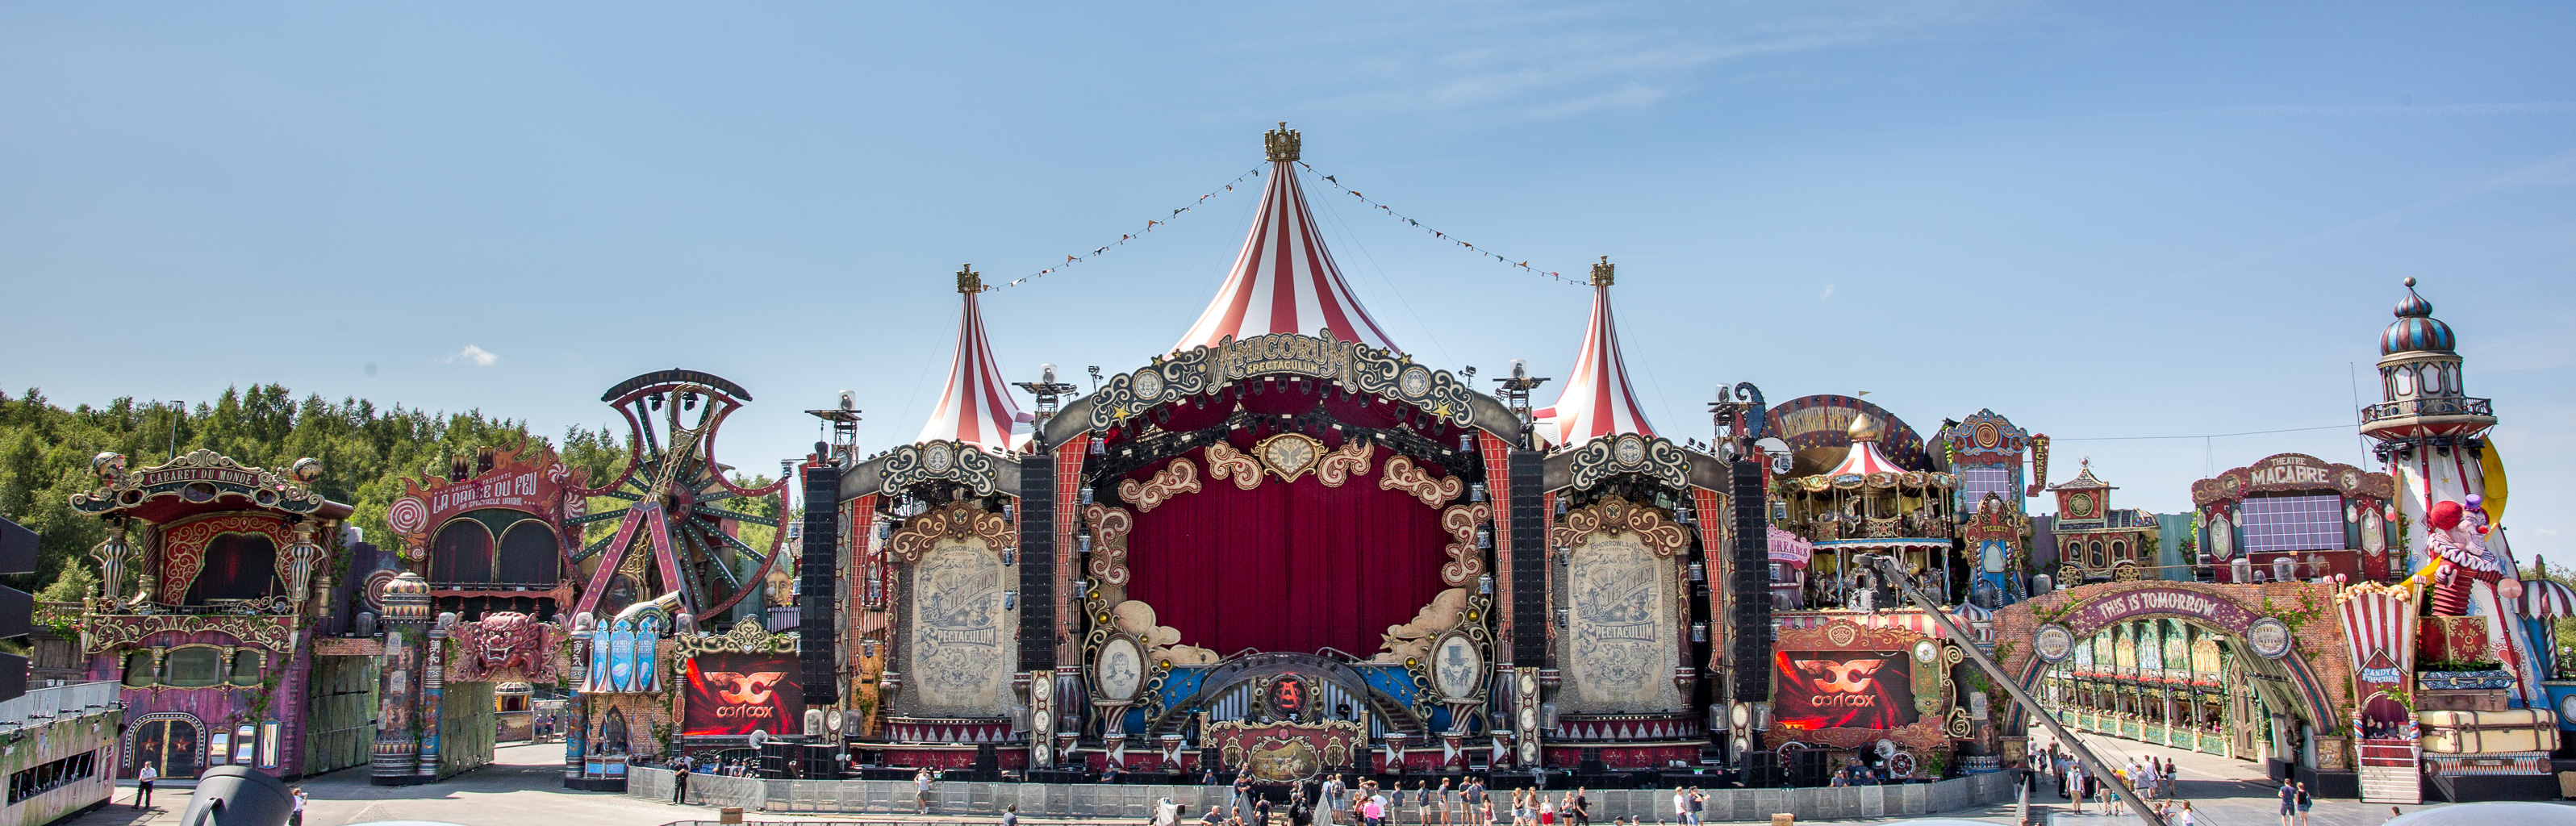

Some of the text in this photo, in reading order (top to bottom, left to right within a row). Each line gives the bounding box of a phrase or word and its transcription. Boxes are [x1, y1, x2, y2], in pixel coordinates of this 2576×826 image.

[1208, 329, 1356, 393] AMICORUM
[1247, 361, 1318, 374] SPECTACULUM
[616, 372, 735, 394] WHEEL OF AMICORUM
[1779, 406, 1887, 444] AMICORUM SPECTAUM
[2034, 439, 2046, 486] TICKETS
[2271, 457, 2307, 466] THEATRE
[149, 469, 253, 485] CABARET DU MONDE
[2251, 465, 2330, 486] MACABRE
[432, 494, 449, 514] LA
[495, 480, 511, 497] DU
[515, 471, 537, 496] FEU
[469, 498, 500, 508] SPECTACLE
[503, 497, 523, 506] UNIQUE
[1981, 524, 2009, 533] TICKETS
[936, 545, 985, 560] TOMORROWLAND
[1589, 540, 1640, 553] TOMORROWLAND
[1770, 540, 1808, 557] DREAMS
[2141, 591, 2219, 617] TOMORROW
[921, 625, 995, 657] SPECTACULUM
[1579, 622, 1654, 653] SPECTACULUM
[2461, 644, 2478, 653] PUSH
[2362, 673, 2400, 684] POPCORN
[2364, 667, 2400, 677] CANDY &
